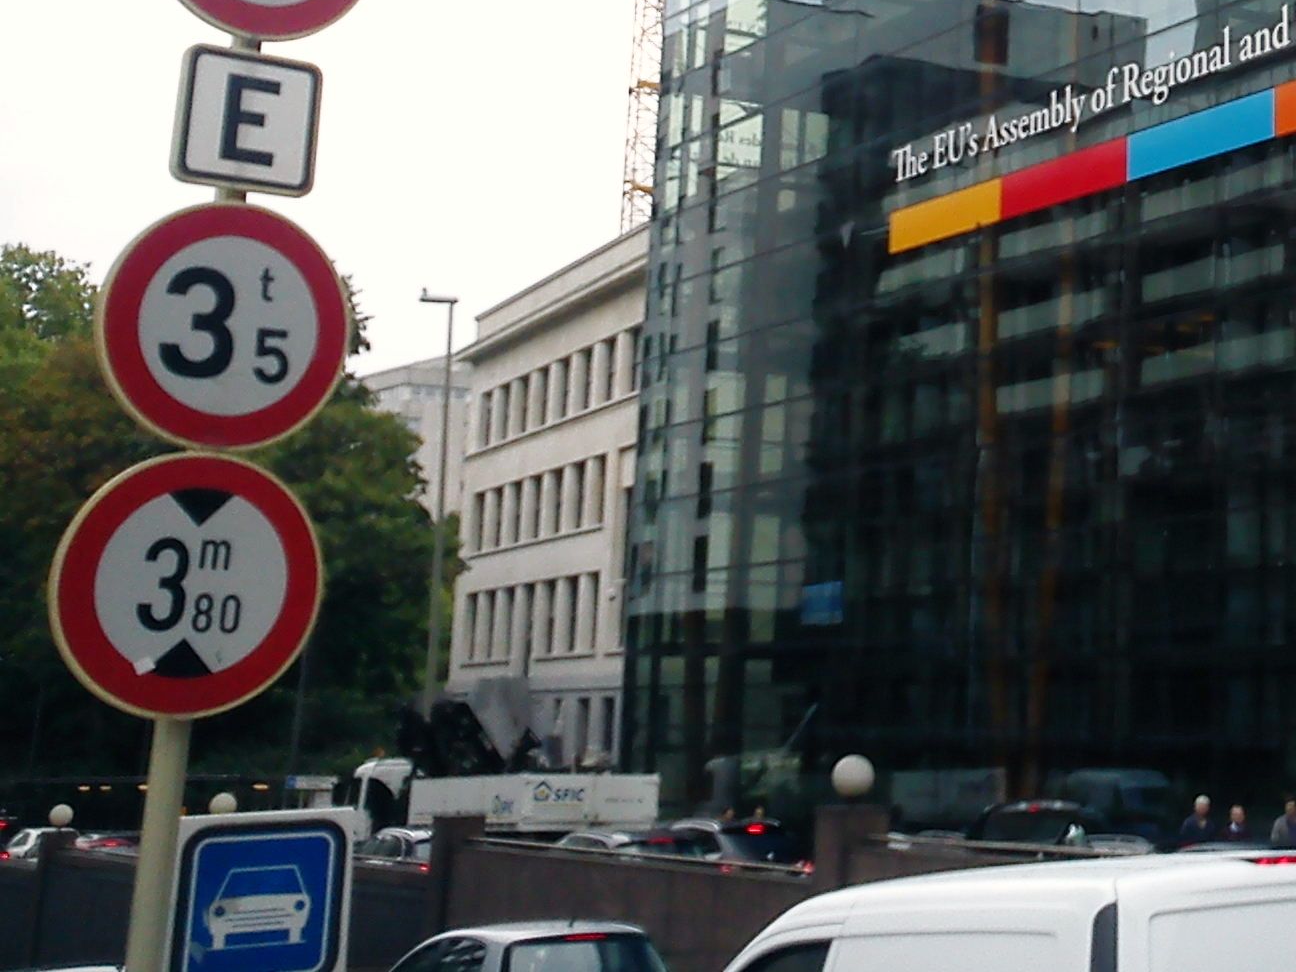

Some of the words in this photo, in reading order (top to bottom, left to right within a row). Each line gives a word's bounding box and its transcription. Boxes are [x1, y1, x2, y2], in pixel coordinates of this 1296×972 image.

[219, 73, 281, 167] E
[891, 144, 928, 182] The
[933, 121, 978, 169] EU's
[983, 83, 1087, 152] Assembly
[1091, 67, 1119, 113] of
[1122, 26, 1231, 105] Regional
[1239, 4, 1290, 61] and
[158, 266, 236, 379] 3
[253, 329, 289, 384] 5
[136, 536, 189, 632] 3
[198, 539, 231, 570] m
[192, 593, 241, 633] 80
